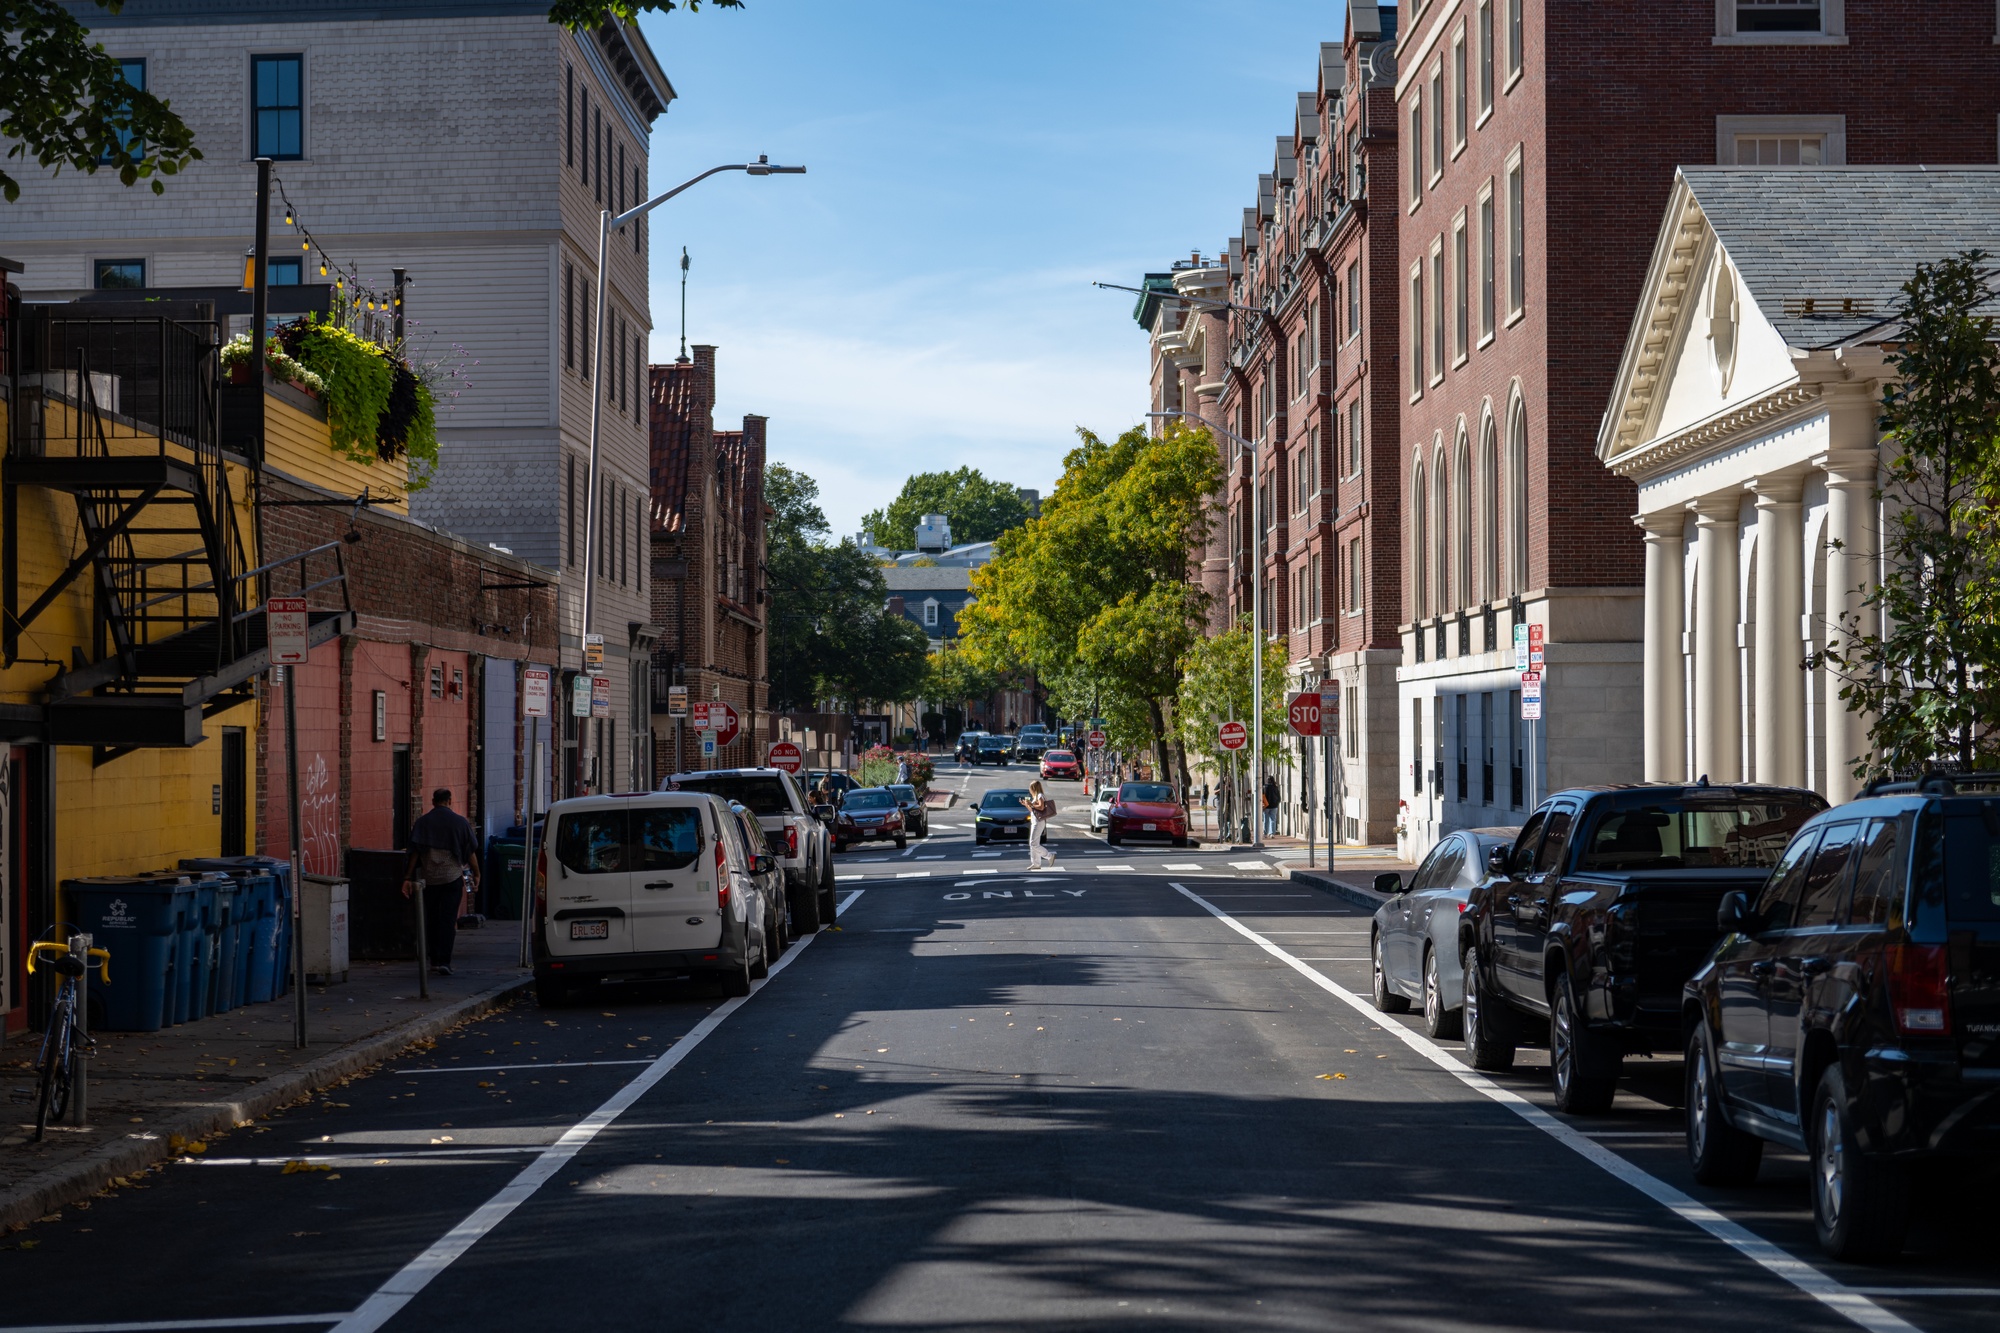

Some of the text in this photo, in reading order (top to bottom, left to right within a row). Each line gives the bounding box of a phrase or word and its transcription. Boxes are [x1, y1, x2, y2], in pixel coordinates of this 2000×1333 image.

[270, 602, 305, 611] TOW ZONE
[1531, 653, 1542, 662] SNOW
[1292, 706, 1319, 723] STO
[943, 890, 1086, 900] ONLY
[574, 925, 606, 936] 1RL 589
